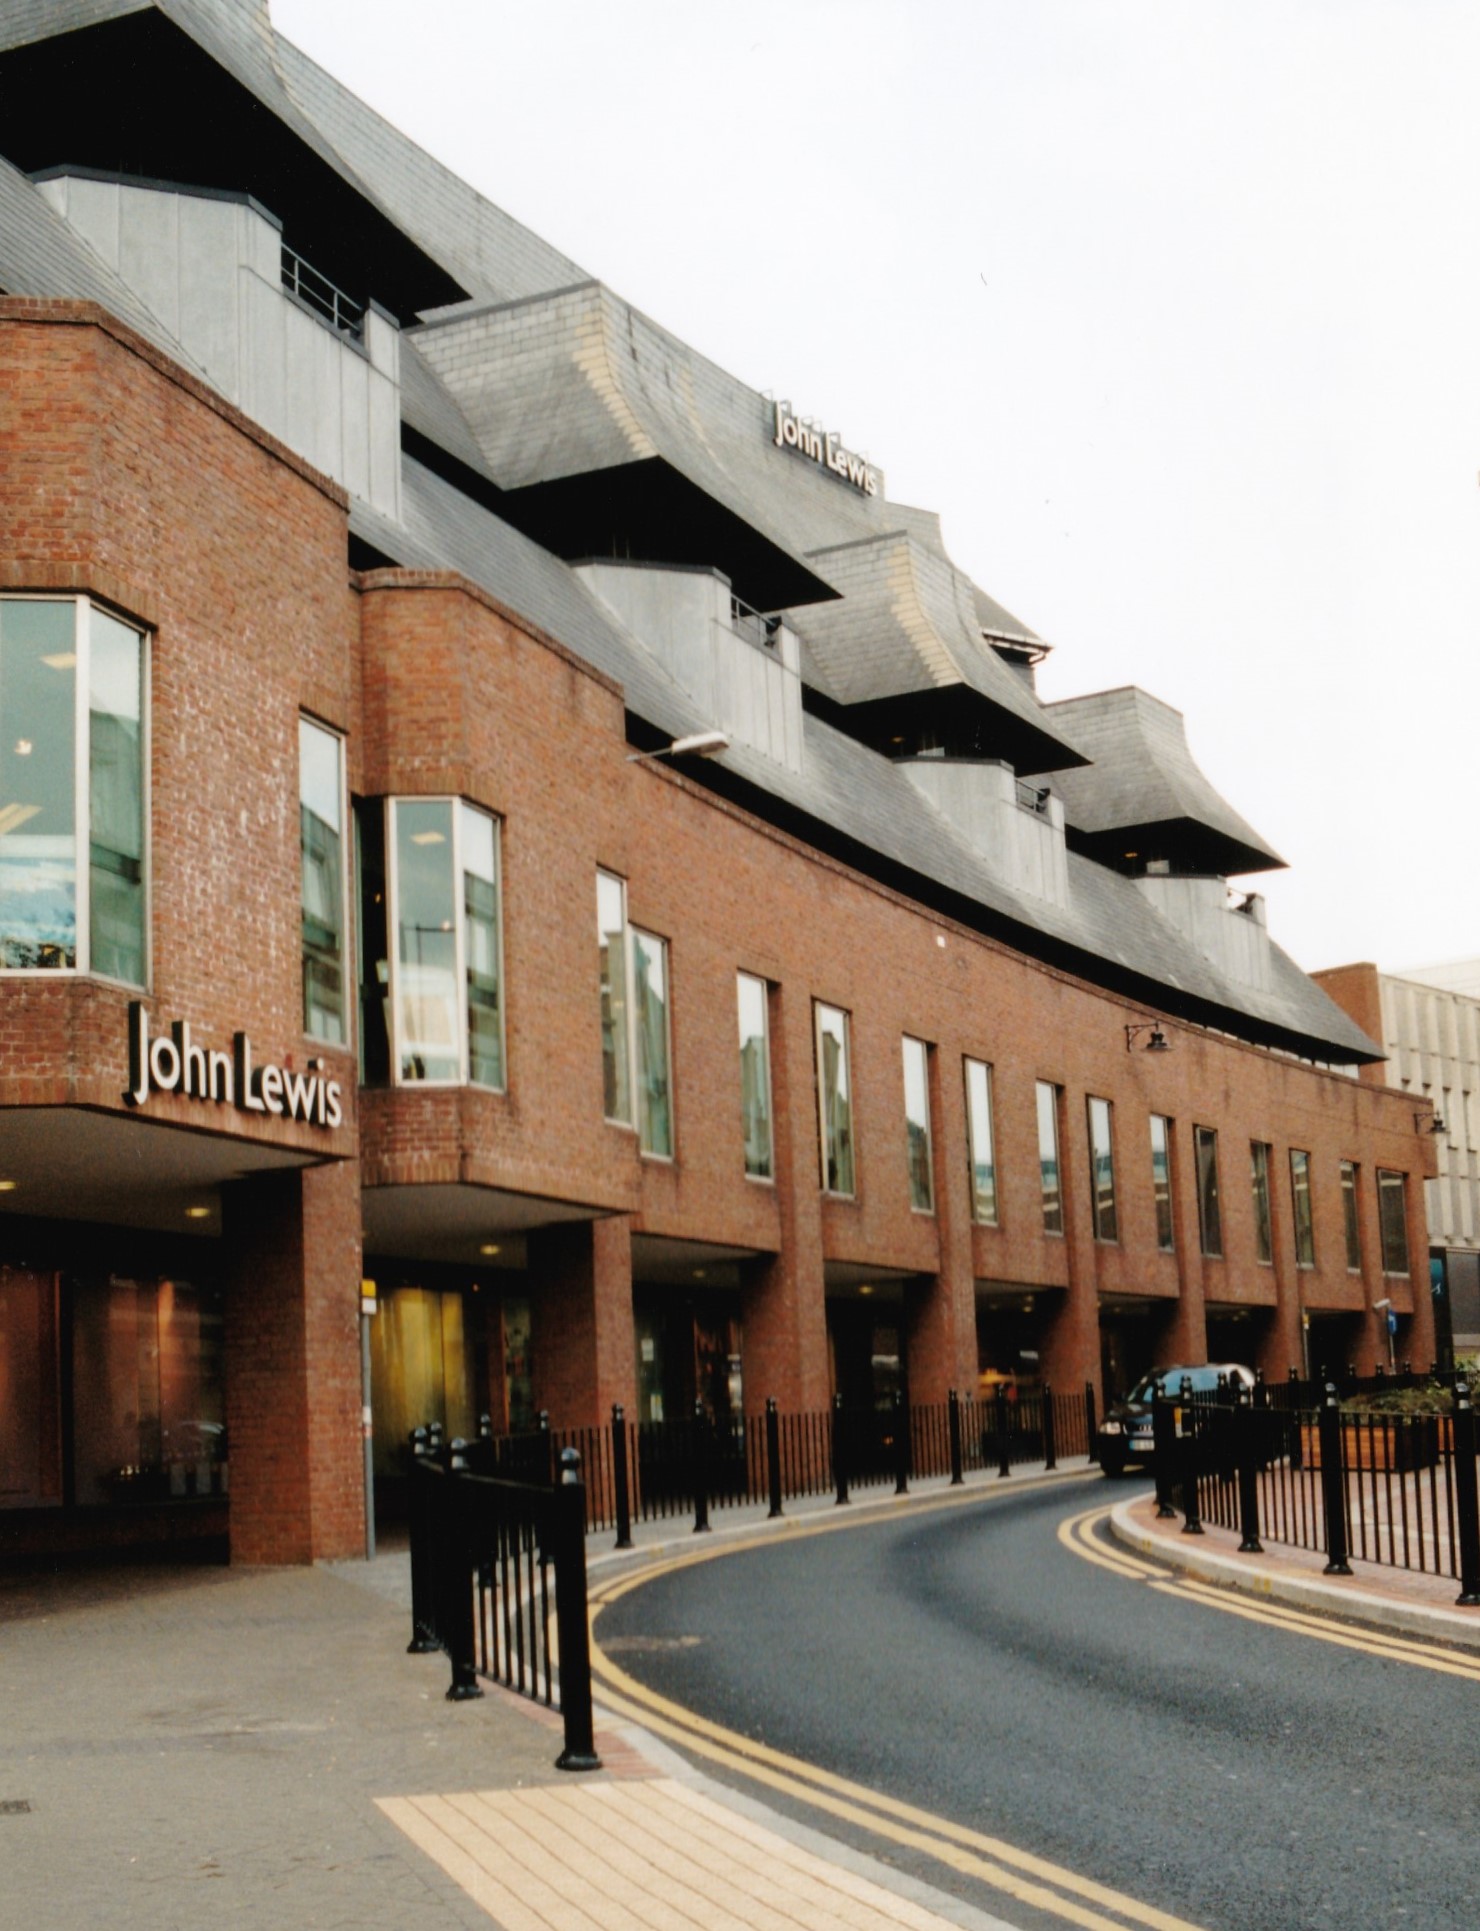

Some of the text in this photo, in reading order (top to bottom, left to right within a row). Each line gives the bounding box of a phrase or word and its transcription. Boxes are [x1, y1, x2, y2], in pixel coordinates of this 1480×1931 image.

[774, 401, 877, 496] John Lewis
[130, 1001, 342, 1128] John Lewis
